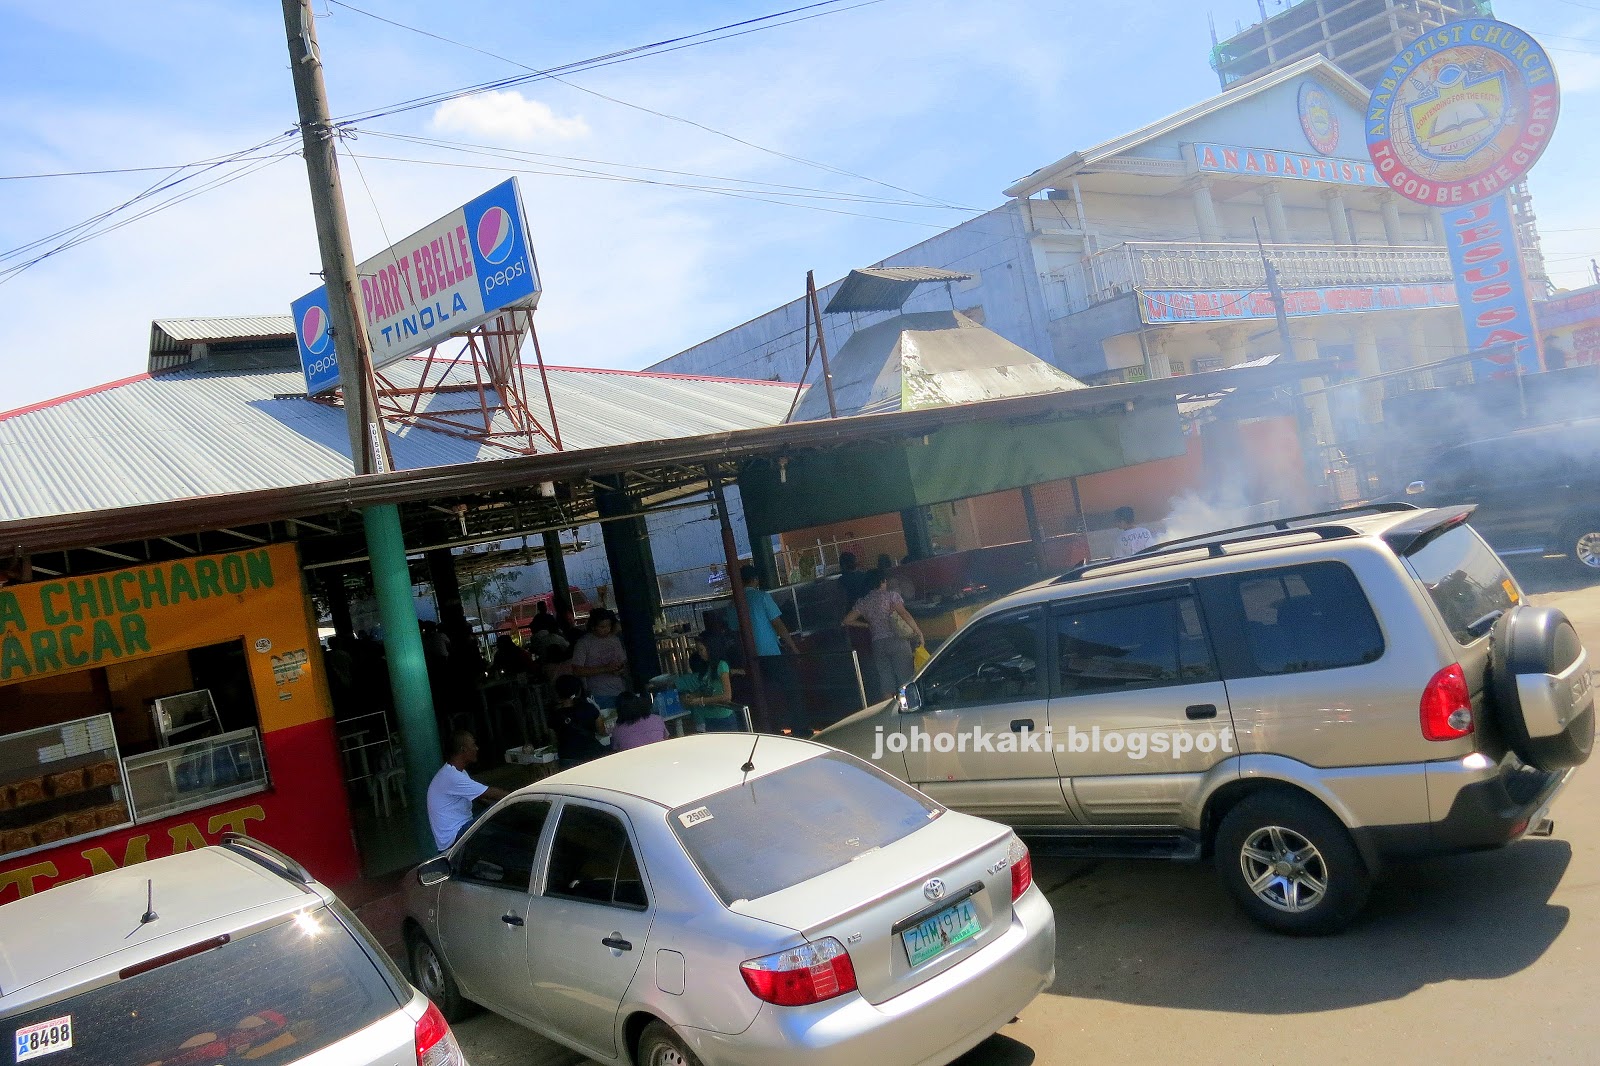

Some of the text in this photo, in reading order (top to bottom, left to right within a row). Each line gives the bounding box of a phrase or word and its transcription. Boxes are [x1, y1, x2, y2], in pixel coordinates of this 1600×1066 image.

[1369, 24, 1549, 136] ANABAPTIST CHURCH
[1416, 98, 1452, 130] CONTENDING
[1452, 93, 1465, 103] FOR
[1467, 92, 1480, 100] THE
[1202, 146, 1365, 183] ANABAPTIST
[1375, 143, 1396, 172] TO
[1392, 172, 1431, 200] GOD
[1436, 186, 1462, 202] BE
[1468, 165, 1513, 198] THE
[1511, 94, 1552, 166] GLORY
[412, 224, 474, 301] EBELLE
[484, 257, 527, 295] pepsi
[381, 292, 468, 348] TINOLA
[308, 348, 338, 381] pepsi
[39, 550, 275, 626] CHICHARON
[910, 921, 940, 952] ZHM
[942, 904, 973, 933] 974
[30, 1023, 70, 1050] 8498
